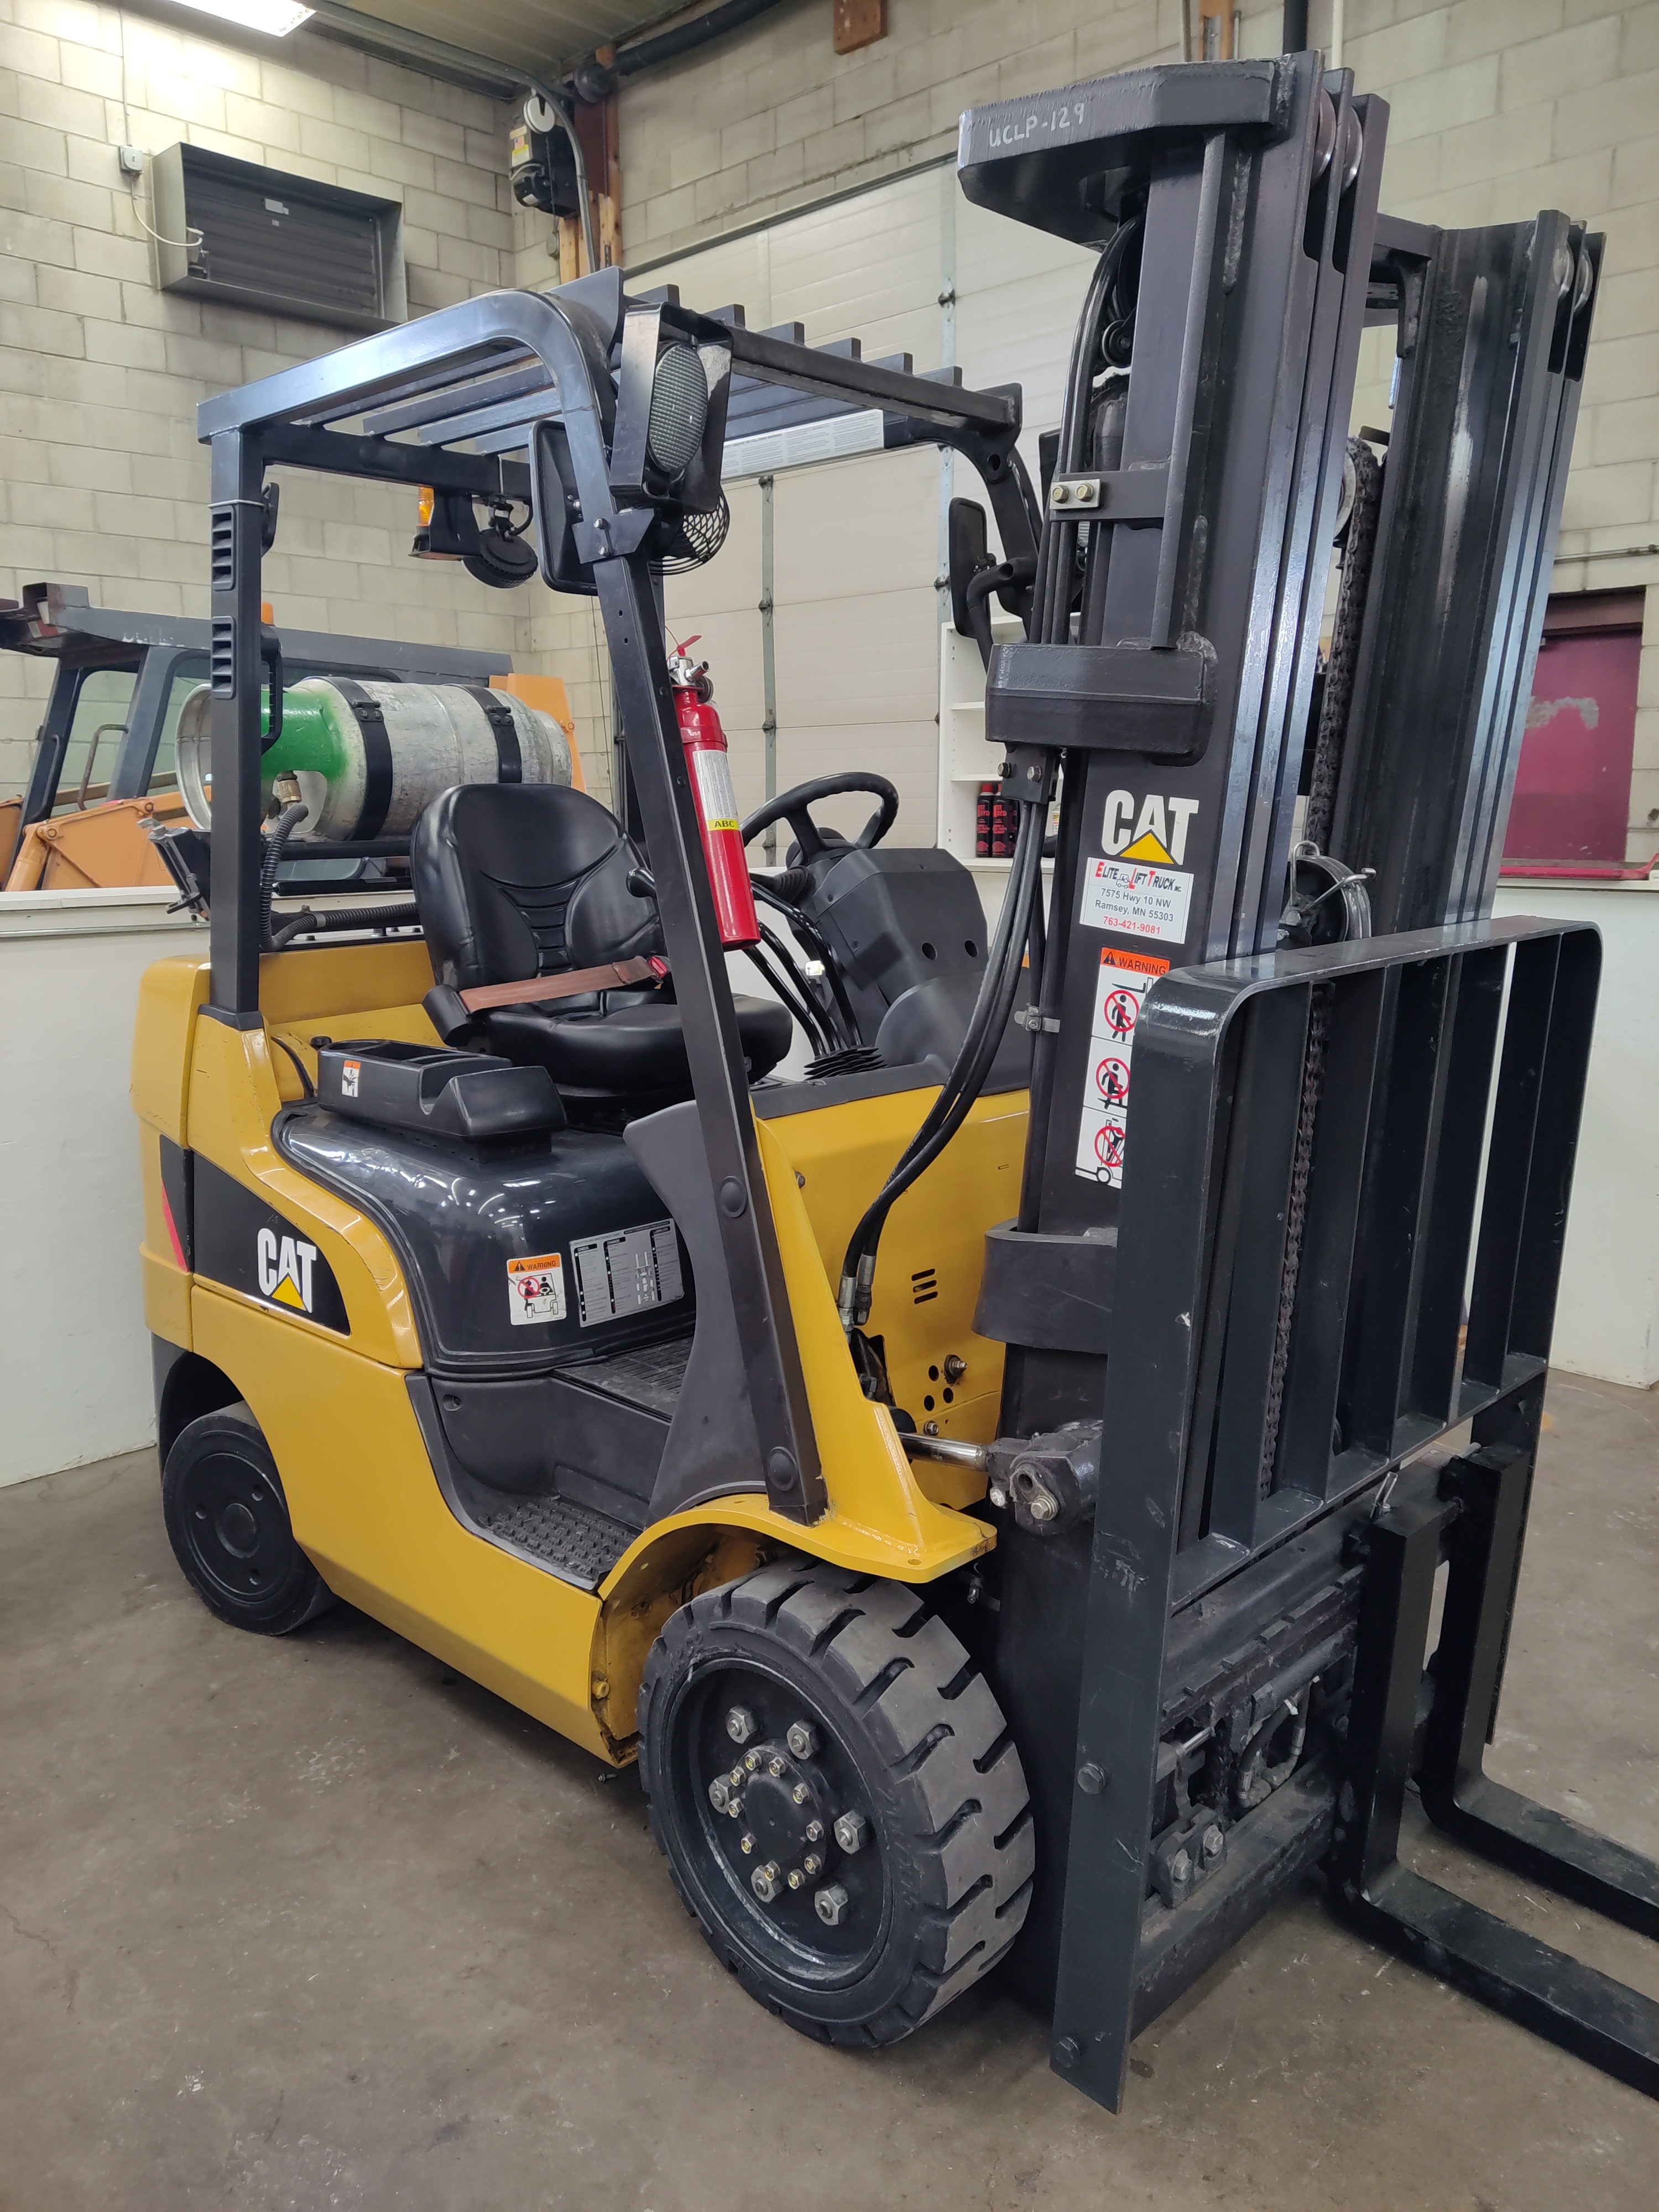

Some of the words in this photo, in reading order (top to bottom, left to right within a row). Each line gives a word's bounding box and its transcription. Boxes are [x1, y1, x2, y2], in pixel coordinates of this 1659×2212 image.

[989, 102, 1084, 147] UCLP-129
[1102, 789, 1199, 865] CAT
[1095, 861, 1120, 880] ELITE
[1128, 867, 1149, 889] LIFT
[1147, 870, 1176, 891] TRUCK
[1101, 888, 1120, 899] 7575
[1123, 891, 1141, 905] Hwy
[1144, 895, 1153, 905] 10
[1155, 898, 1172, 909] NW
[1095, 899, 1129, 915] Ramsey,
[1132, 906, 1146, 917] MN
[1149, 910, 1173, 922] 55303
[1103, 916, 1160, 935] 763-421-9081
[1119, 956, 1166, 975] WARNING
[257, 1228, 317, 1313] CAT
[526, 1260, 556, 1270] WARNING
